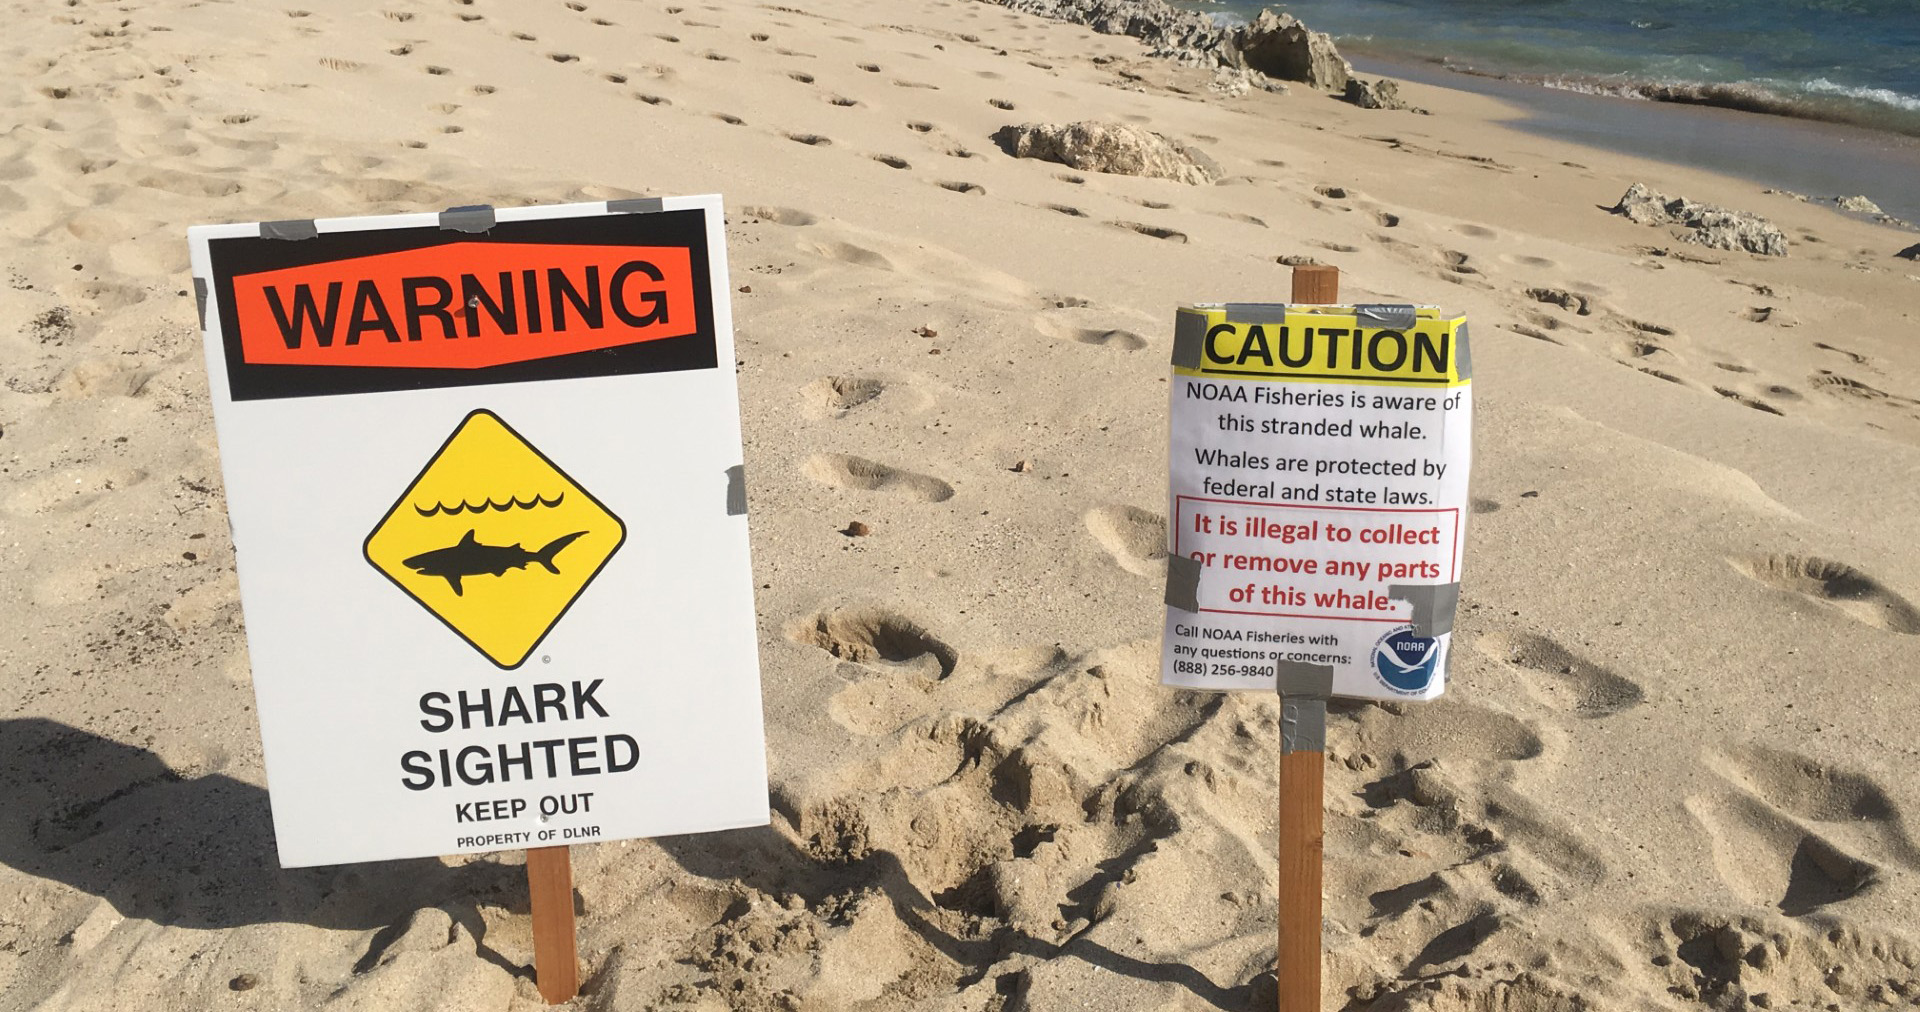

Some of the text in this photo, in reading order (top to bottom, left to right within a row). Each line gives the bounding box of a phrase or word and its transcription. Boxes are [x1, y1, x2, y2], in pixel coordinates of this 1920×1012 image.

[263, 260, 670, 350] WARNING
[1204, 323, 1449, 373] CAUTION
[1186, 381, 1462, 411] NOAA Fisheries is aware of
[1218, 413, 1427, 440] this stranded whale.
[1194, 447, 1447, 480] Whales are protected by
[1203, 476, 1433, 505] federal and state laws.
[1194, 513, 1440, 545] It is illegal to collect
[1223, 554, 1318, 575] remove
[1325, 559, 1370, 581] any
[1378, 559, 1440, 582] parts
[1229, 583, 1396, 611] of this whale.
[1175, 624, 1338, 646] Call NOAA Fisheries with
[1397, 641, 1425, 651] NOAA
[1173, 643, 1351, 665] any questions or concerns:
[1173, 659, 1274, 677] (888) 256-9840
[419, 678, 610, 733] SHARK
[400, 733, 640, 791] SIGHTED
[455, 792, 594, 823] KEEP OUT
[457, 826, 601, 848] PROPERTY OF DLNR
